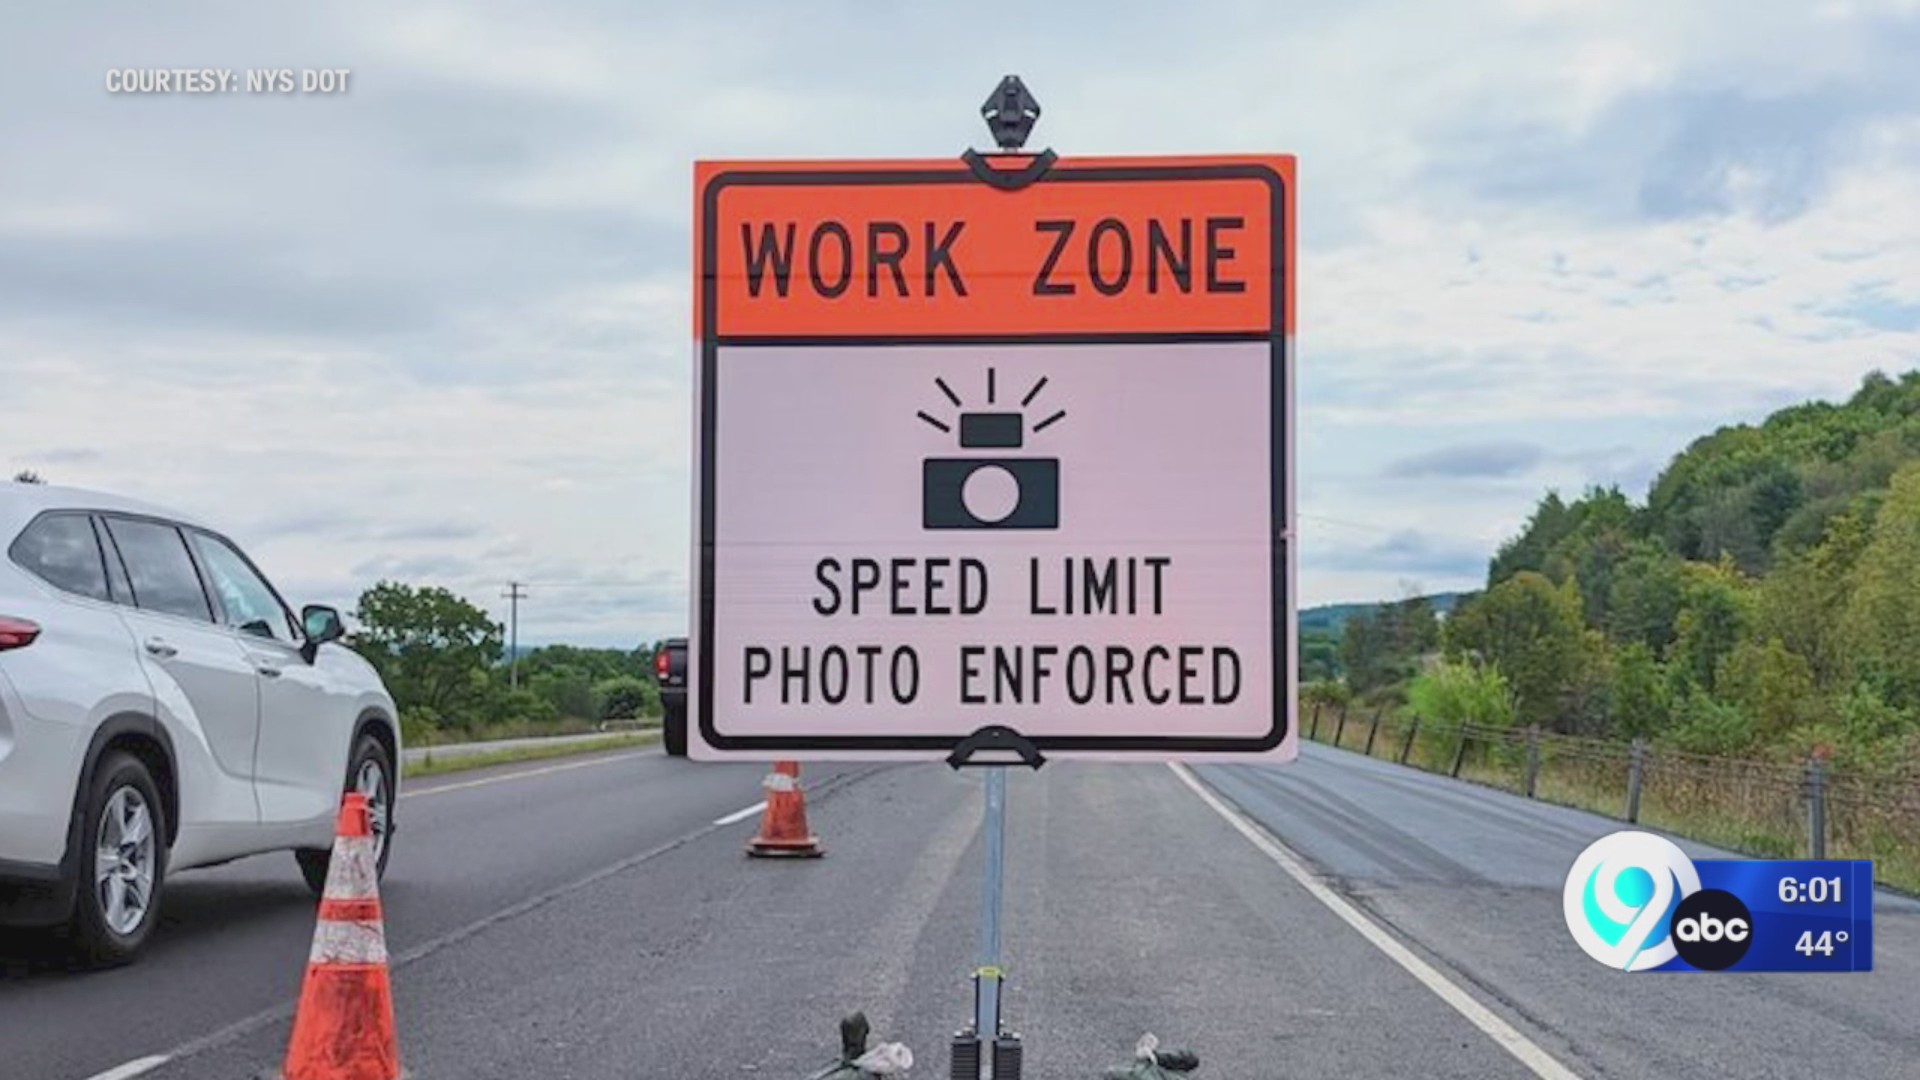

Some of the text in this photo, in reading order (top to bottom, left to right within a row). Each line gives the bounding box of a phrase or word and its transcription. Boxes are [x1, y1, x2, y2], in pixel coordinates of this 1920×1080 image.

[741, 217, 1247, 299] WORK ZONE
[812, 556, 1173, 617] SPEED LIMIT
[742, 645, 1242, 706] PHOTO ENFORCED
